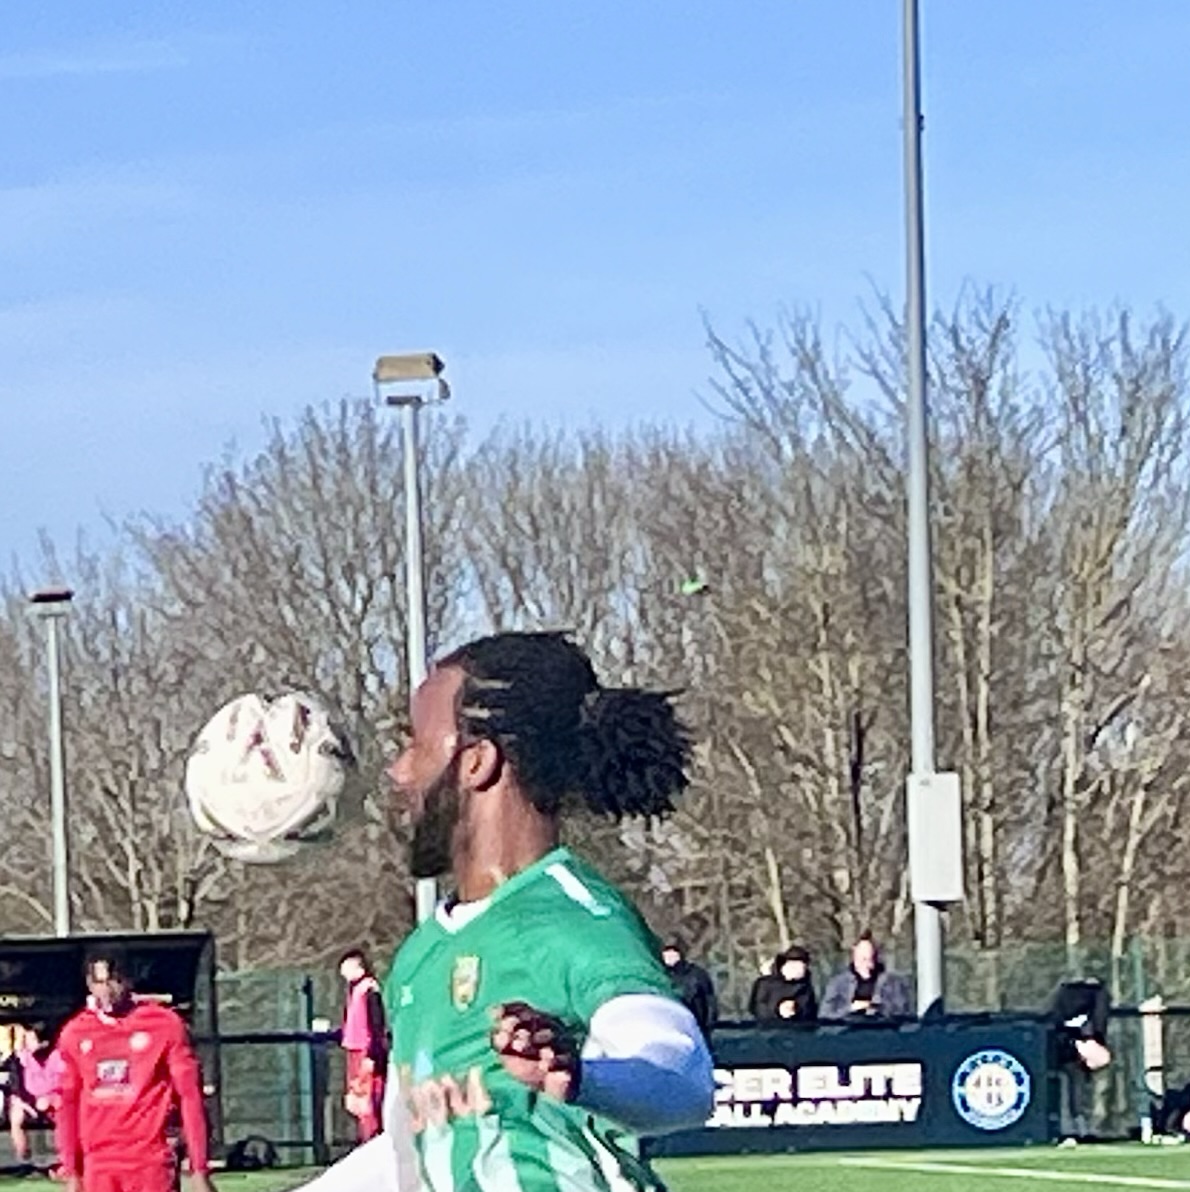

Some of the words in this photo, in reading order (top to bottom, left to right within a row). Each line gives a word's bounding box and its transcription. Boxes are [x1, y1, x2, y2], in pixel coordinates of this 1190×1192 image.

[798, 1065, 922, 1098] ELITE
[705, 1102, 773, 1127] ALL
[774, 1098, 922, 1125] ACADEMY
